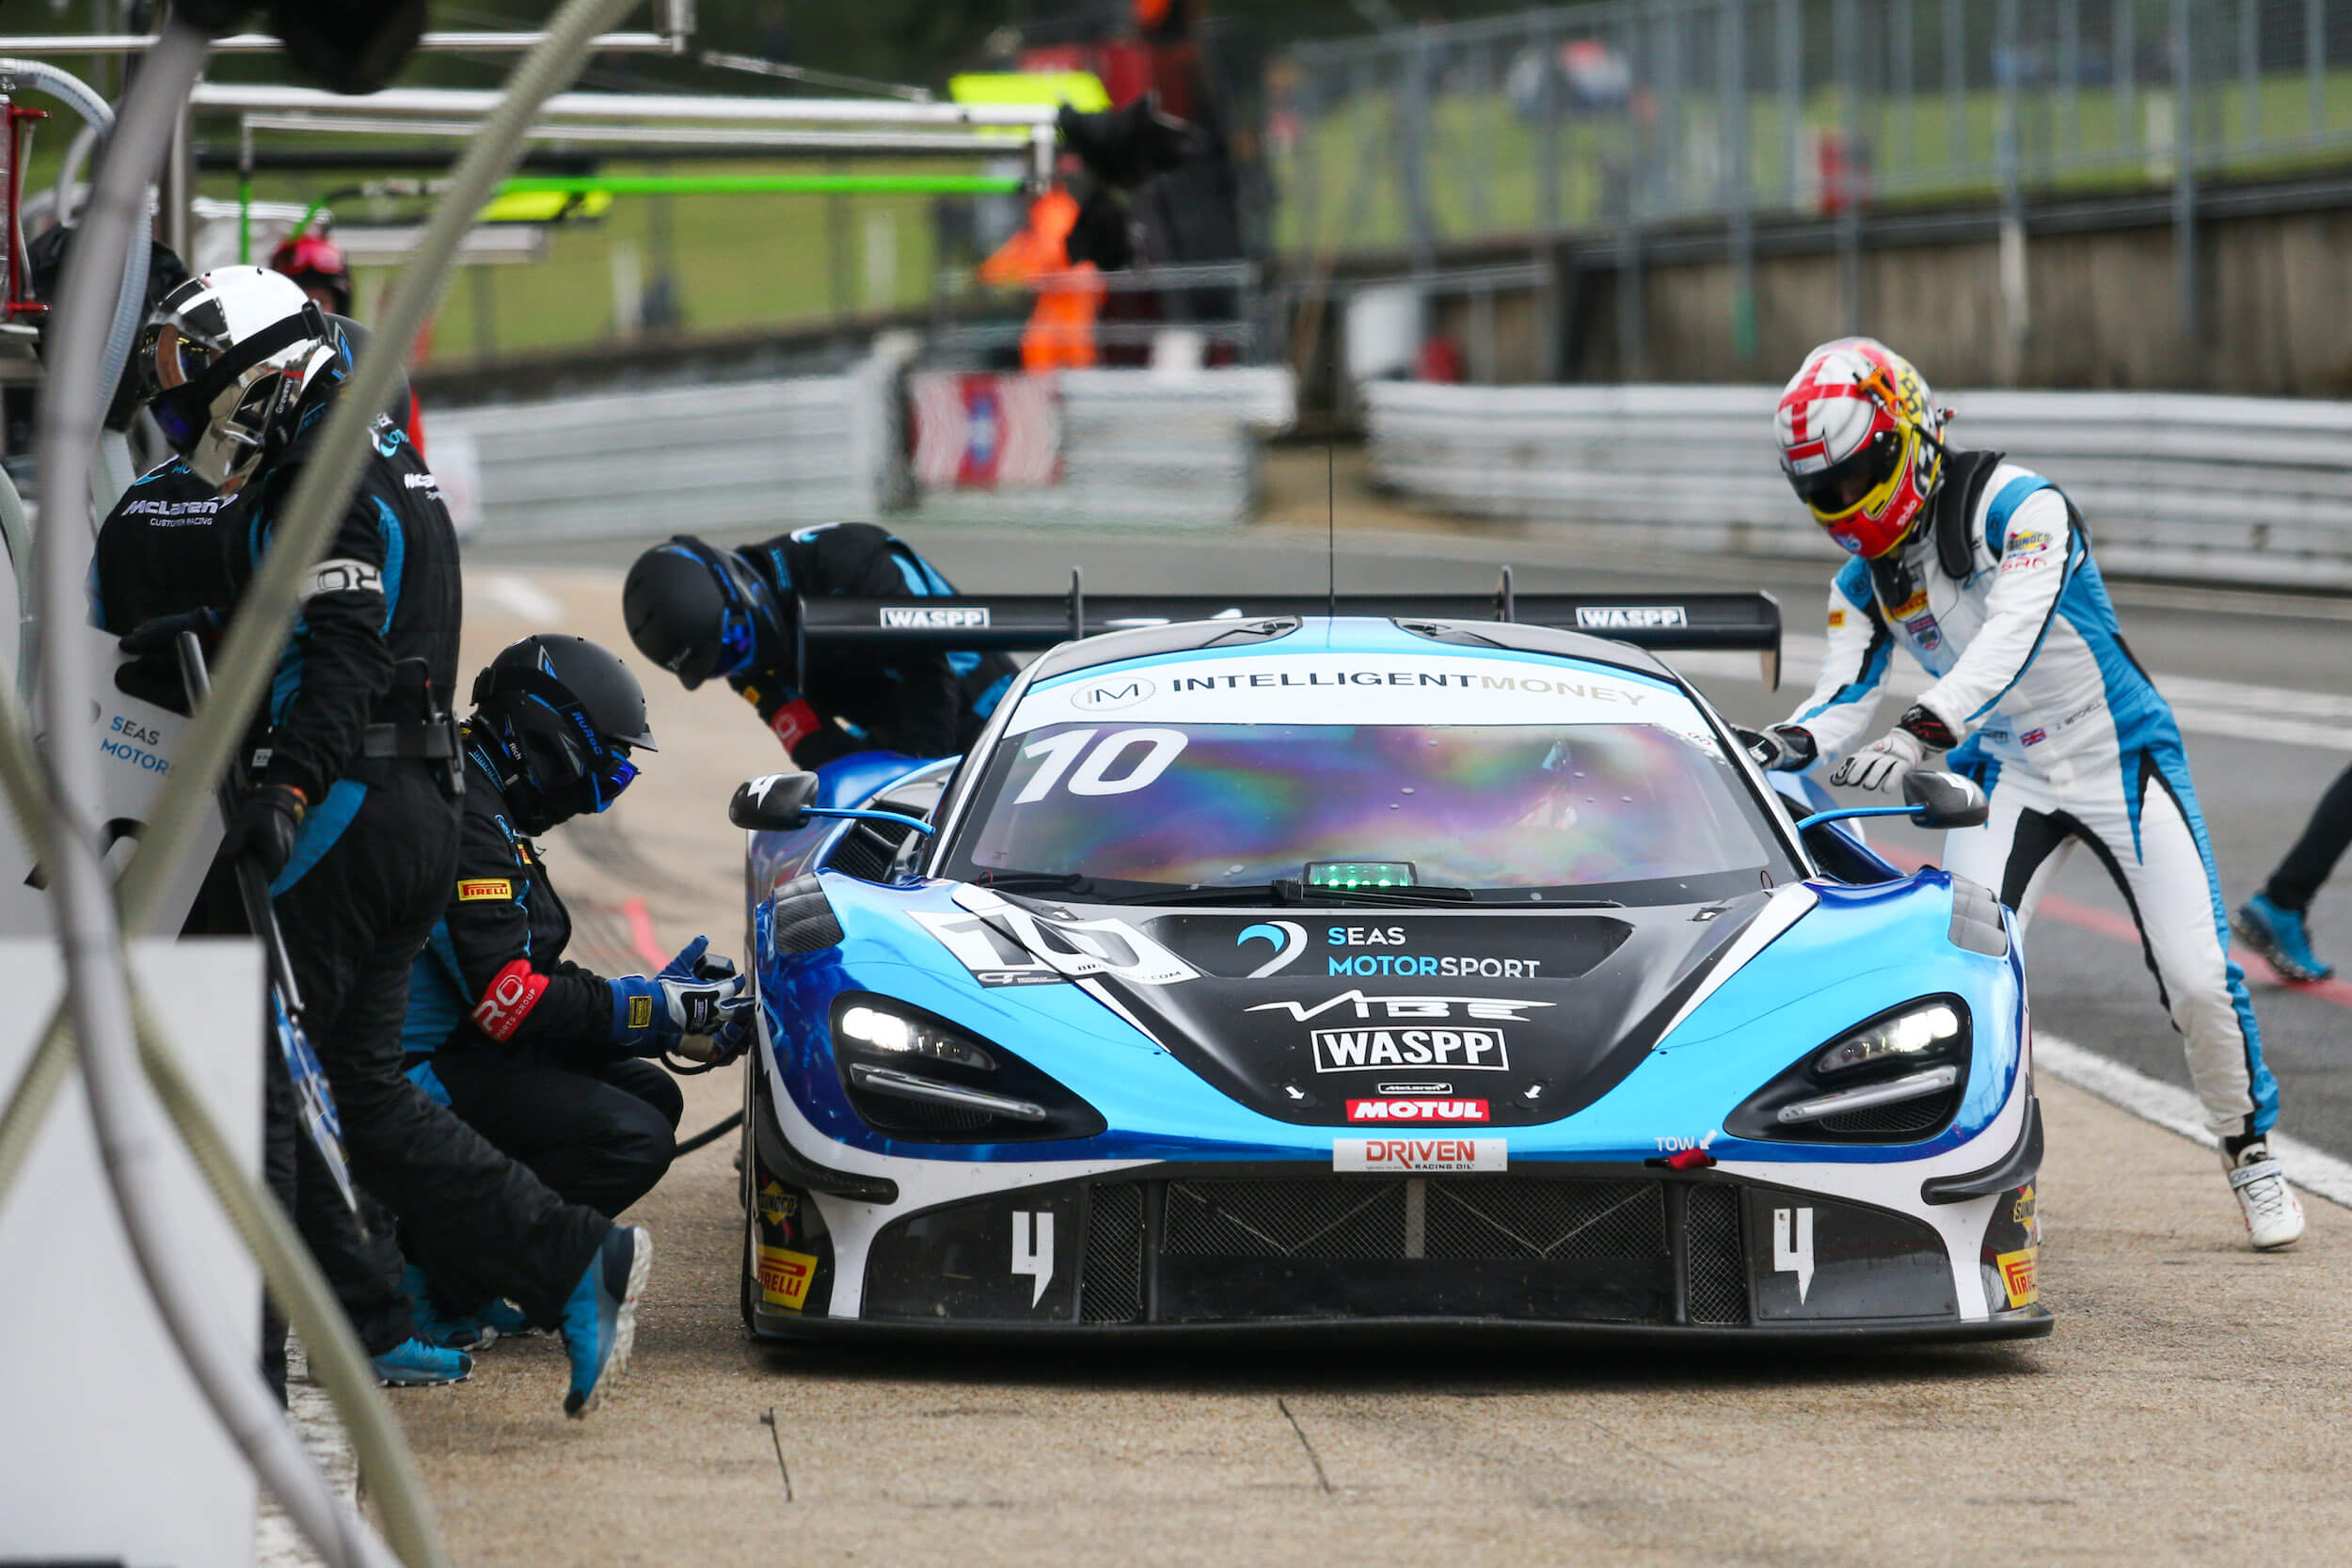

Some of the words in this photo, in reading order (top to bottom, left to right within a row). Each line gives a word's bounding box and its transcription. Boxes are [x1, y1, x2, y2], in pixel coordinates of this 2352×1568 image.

[121, 499, 219, 516] McLaren
[886, 610, 984, 627] WASPP
[1583, 610, 1681, 627] WASPP
[110, 716, 161, 746] SEAS
[509, 741, 522, 761] Rich
[1013, 728, 1188, 804] 10
[463, 882, 508, 897] PIRELLI
[941, 913, 1141, 968] 10
[1327, 927, 1406, 945] SEAS
[1327, 956, 1540, 978] MOTORSPORT
[517, 988, 536, 1016] GROUP
[1323, 1030, 1494, 1067] WASPP
[1354, 1101, 1484, 1119] MOTUL
[1654, 1136, 1695, 1151] TOW
[1366, 1140, 1475, 1169] DRIVEN
